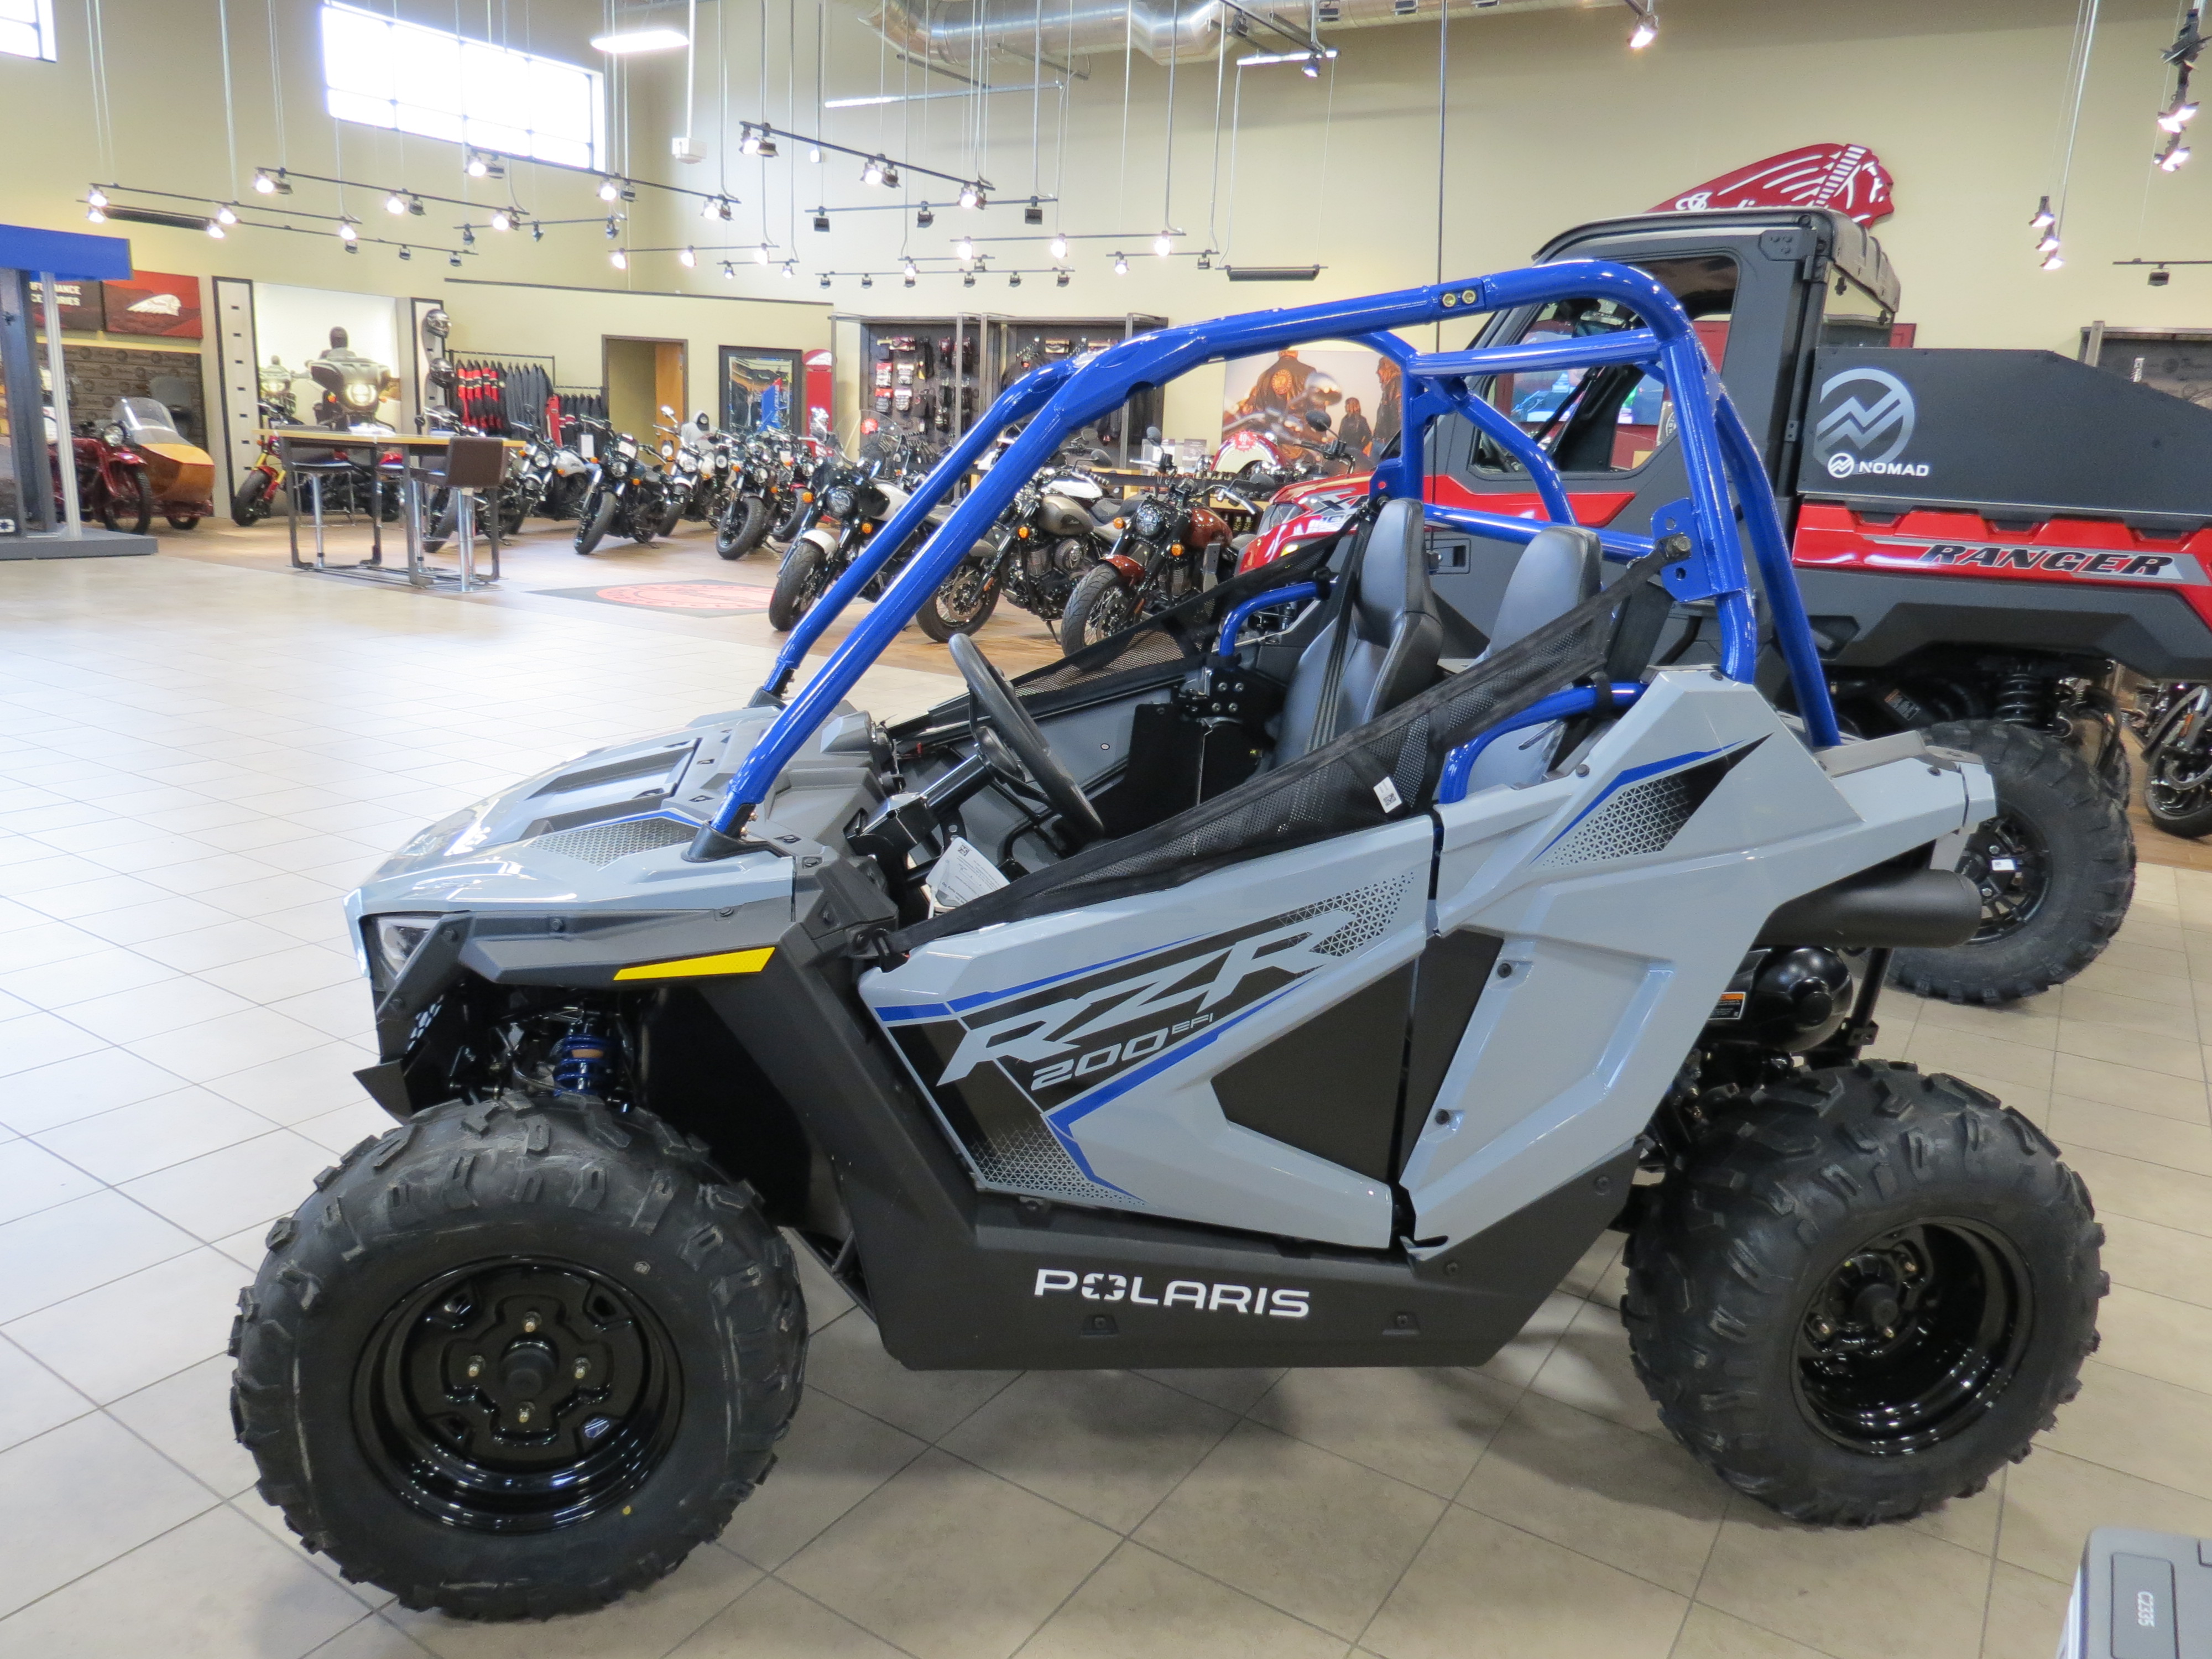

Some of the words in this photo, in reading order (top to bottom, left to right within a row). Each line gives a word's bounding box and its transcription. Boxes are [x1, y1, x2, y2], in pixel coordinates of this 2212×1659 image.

[1858, 461, 1930, 477] NOMAD
[1916, 544, 2173, 575] RANGER
[936, 909, 1356, 1086] RZR
[1031, 1027, 1168, 1091] 200
[1171, 1013, 1213, 1035] EFI
[1034, 1269, 1310, 1318] POLARIS
